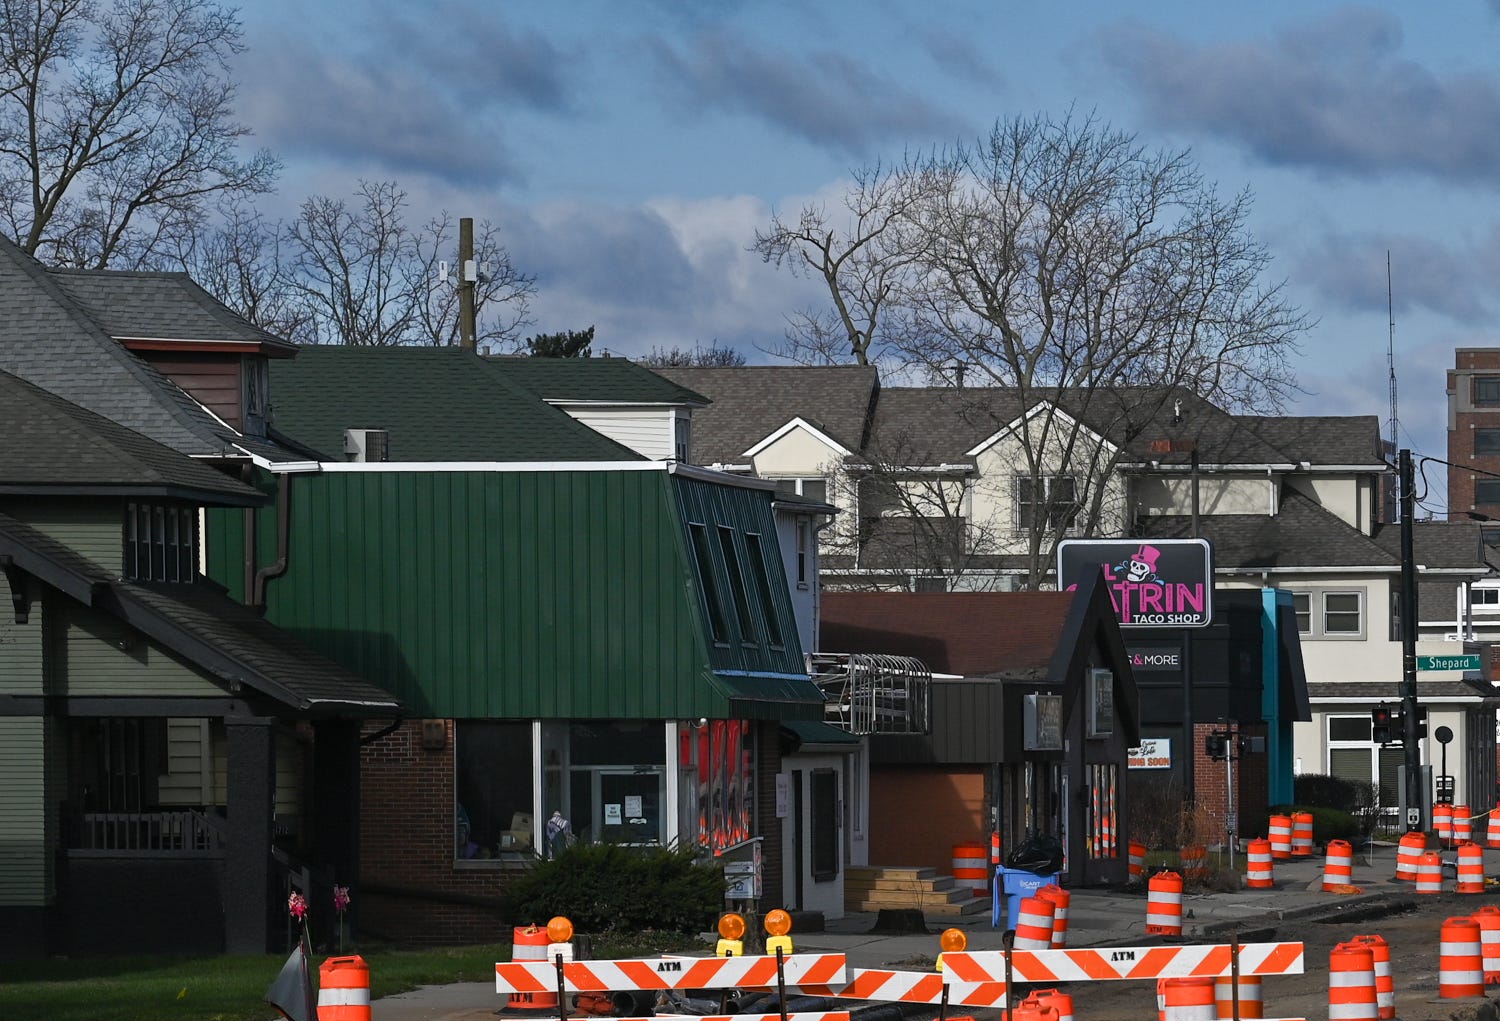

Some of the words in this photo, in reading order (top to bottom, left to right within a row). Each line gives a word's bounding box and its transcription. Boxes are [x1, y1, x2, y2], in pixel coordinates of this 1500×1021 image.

[1133, 614, 1164, 623] TACO
[1167, 614, 1200, 623] SHOP
[1429, 656, 1469, 670] Shepard
[1111, 951, 1135, 962] ATM
[657, 961, 682, 972] ATM
